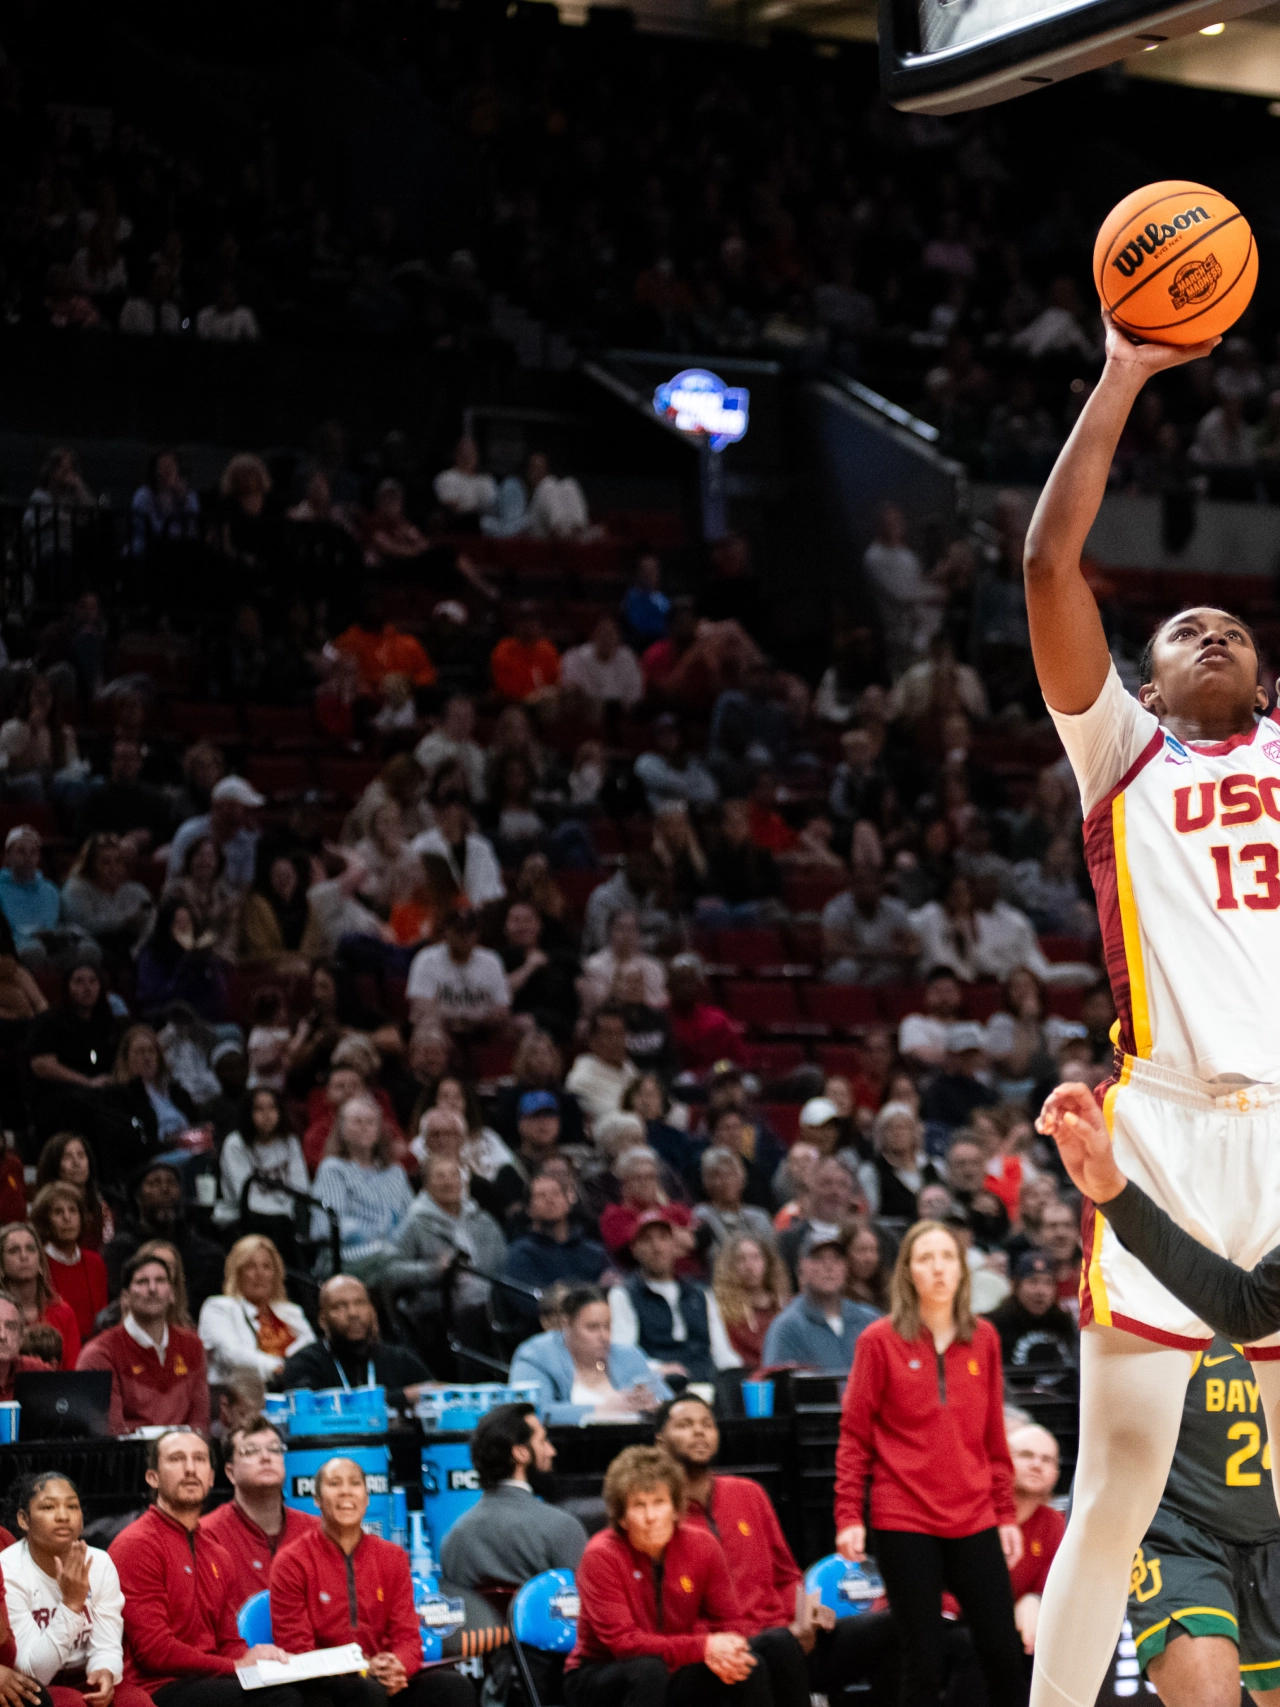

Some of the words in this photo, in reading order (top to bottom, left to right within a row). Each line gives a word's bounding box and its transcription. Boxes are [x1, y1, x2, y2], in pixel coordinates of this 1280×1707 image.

[1112, 206, 1212, 278] Wilson
[1177, 265, 1206, 291] MARCH
[1186, 263, 1222, 297] MADNESS
[1206, 1378, 1260, 1413] BAY
[1226, 1421, 1272, 1487] 2
